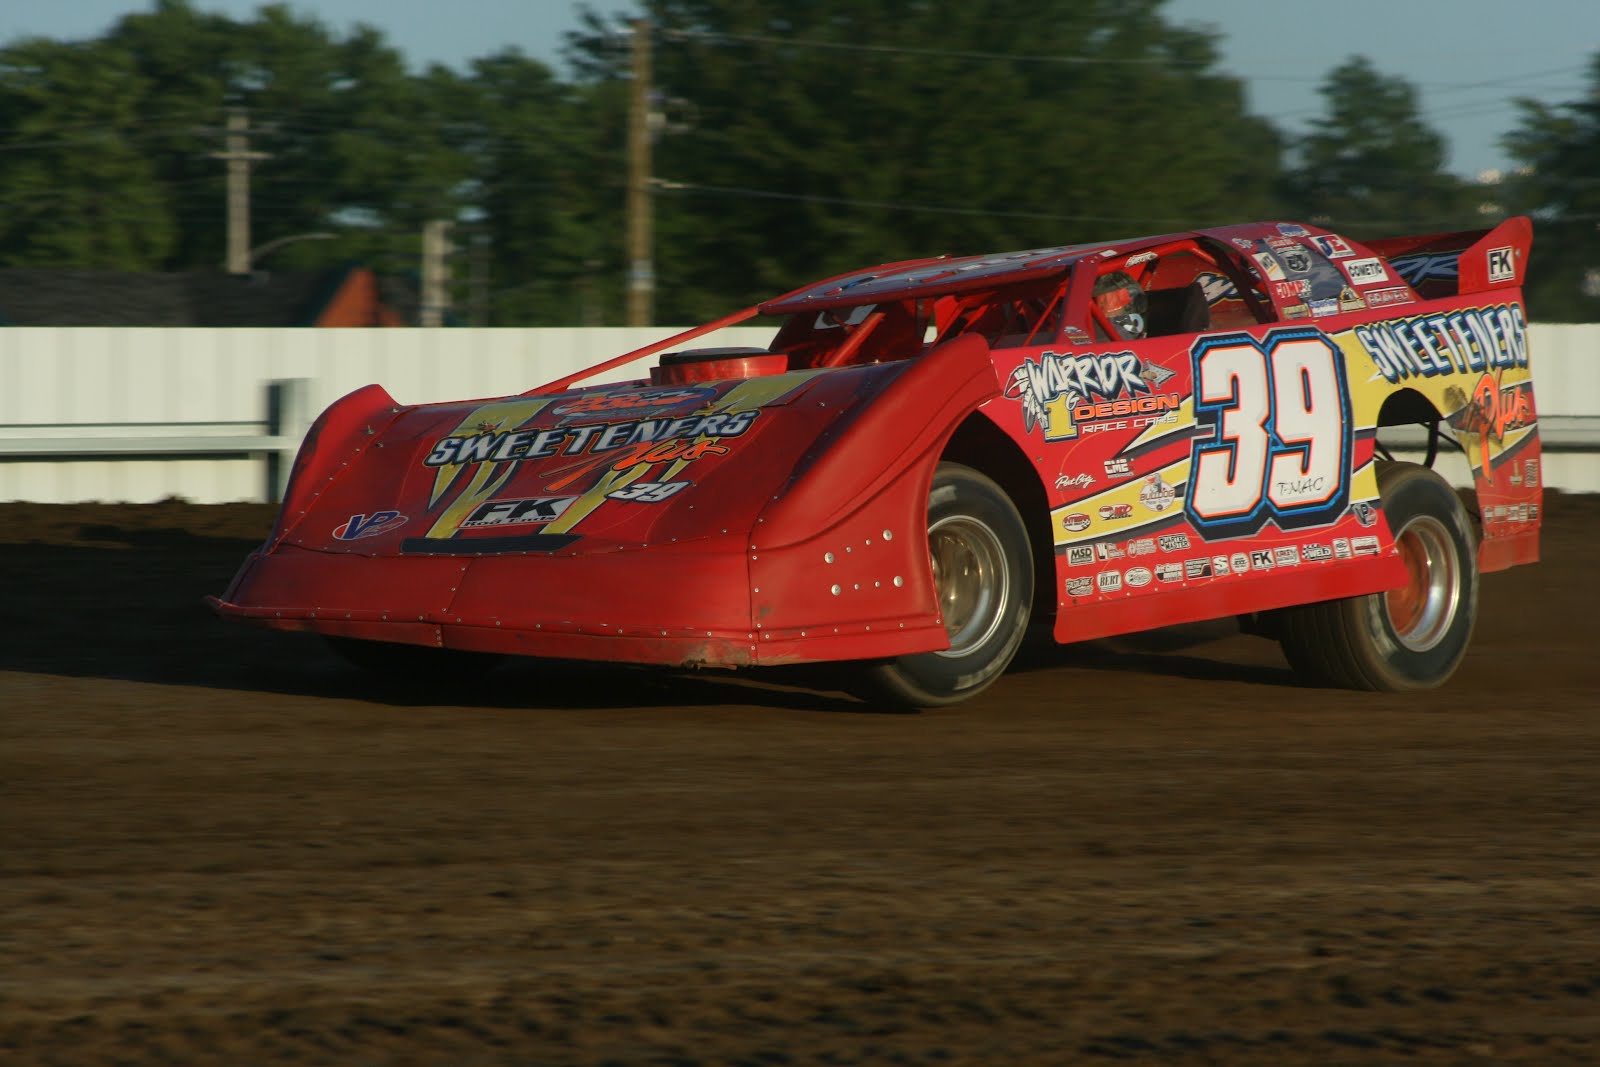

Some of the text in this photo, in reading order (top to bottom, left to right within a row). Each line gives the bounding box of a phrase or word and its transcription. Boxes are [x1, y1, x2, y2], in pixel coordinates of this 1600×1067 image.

[1348, 262, 1383, 277] COMETIC
[1490, 250, 1512, 275] FK
[1354, 303, 1528, 382] SWEETENERS
[1026, 351, 1147, 402] WARRIOR
[1073, 394, 1180, 421] DESIGN
[1082, 414, 1179, 434] RACE CARS
[1188, 334, 1347, 522] 39
[424, 410, 761, 466] SWEETENERS
[604, 481, 693, 502] 39
[467, 497, 572, 521] FK
[341, 511, 400, 540] VP
[1071, 547, 1092, 559] MSD
[1252, 551, 1274, 565] FK
[1100, 574, 1119, 586] BERT
